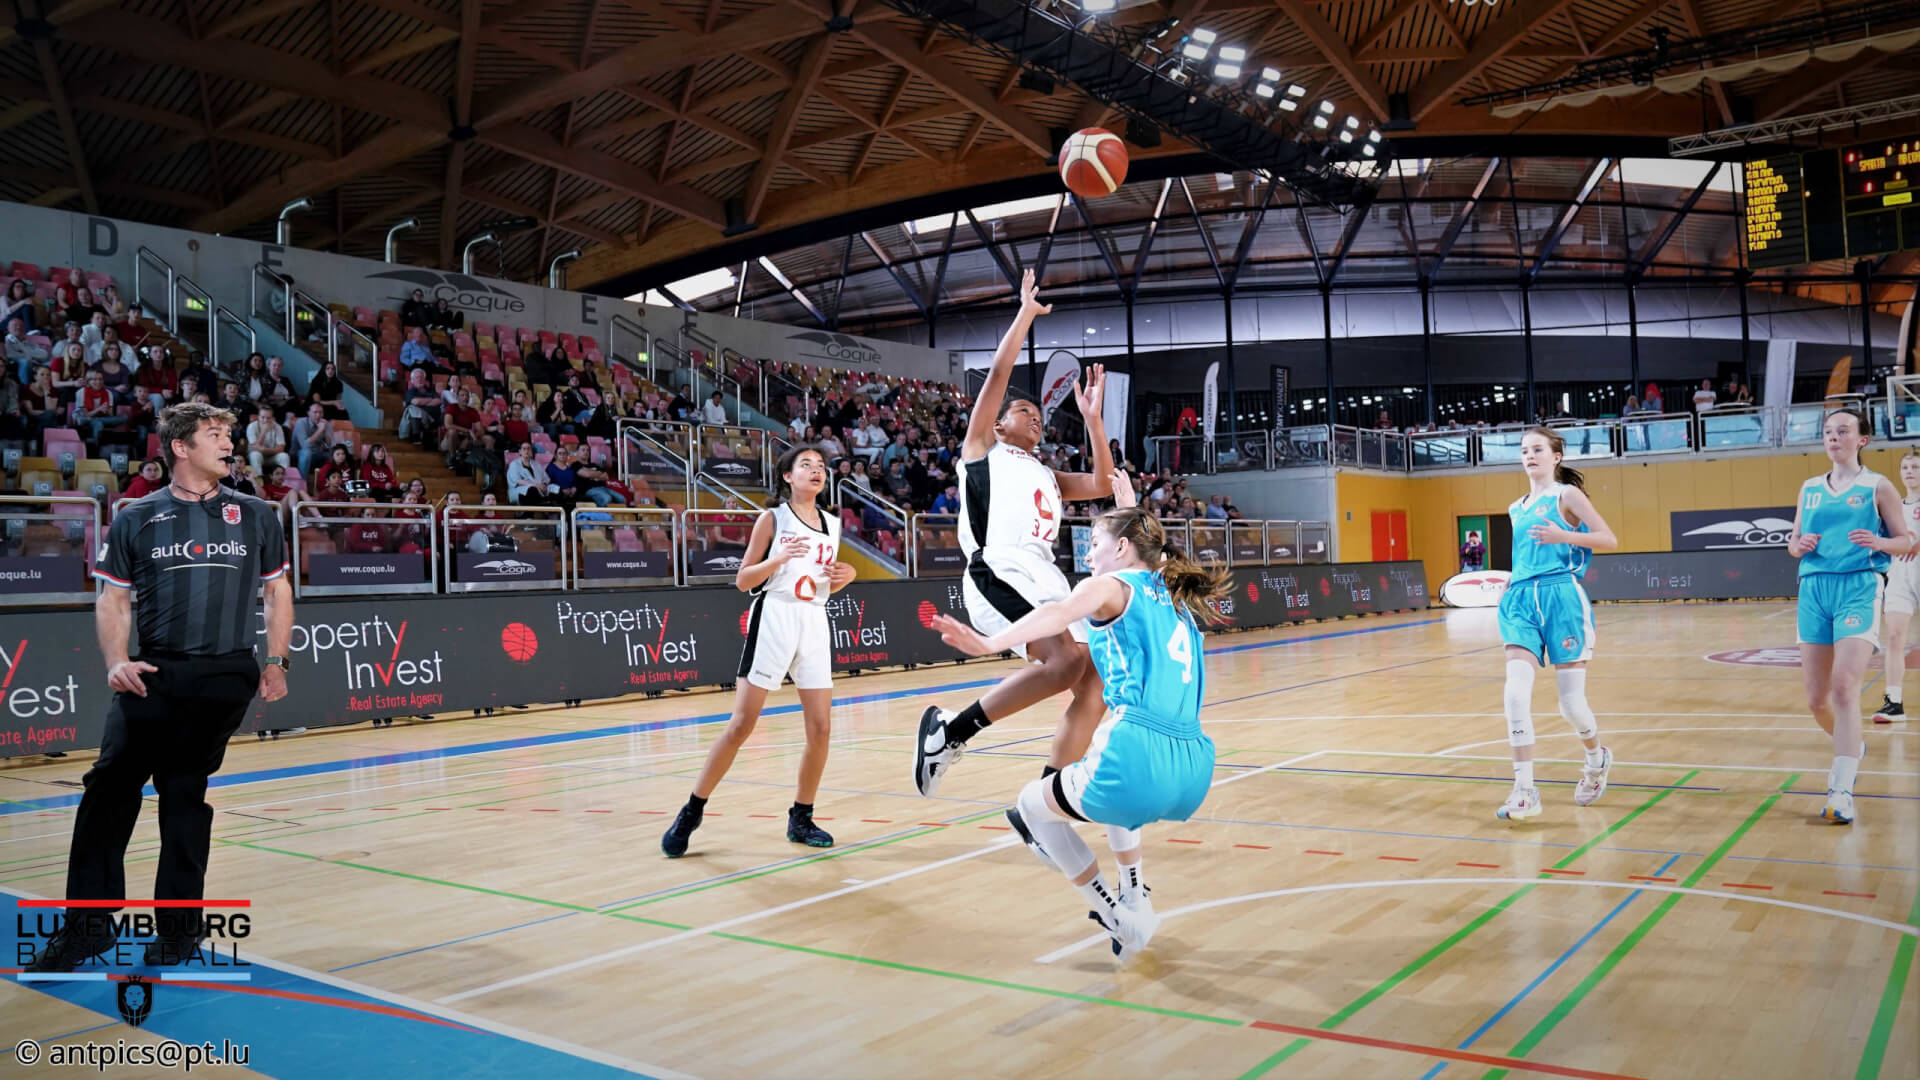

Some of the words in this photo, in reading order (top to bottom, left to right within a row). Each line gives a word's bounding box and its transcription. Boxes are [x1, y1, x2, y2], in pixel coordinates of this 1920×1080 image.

[88, 217, 118, 256] D
[434, 286, 525, 313] Coque
[582, 295, 598, 324] E
[1805, 492, 1822, 509] 10
[815, 543, 834, 566] 12
[341, 564, 395, 575] www.coque.lu
[557, 600, 669, 644] Property
[832, 620, 887, 649] Invest
[625, 633, 697, 667] Invest
[1167, 620, 1192, 684] 4
[345, 650, 442, 689] Invest
[375, 694, 407, 709] Estate
[410, 691, 443, 708] Agency
[27, 726, 77, 746] Agency
